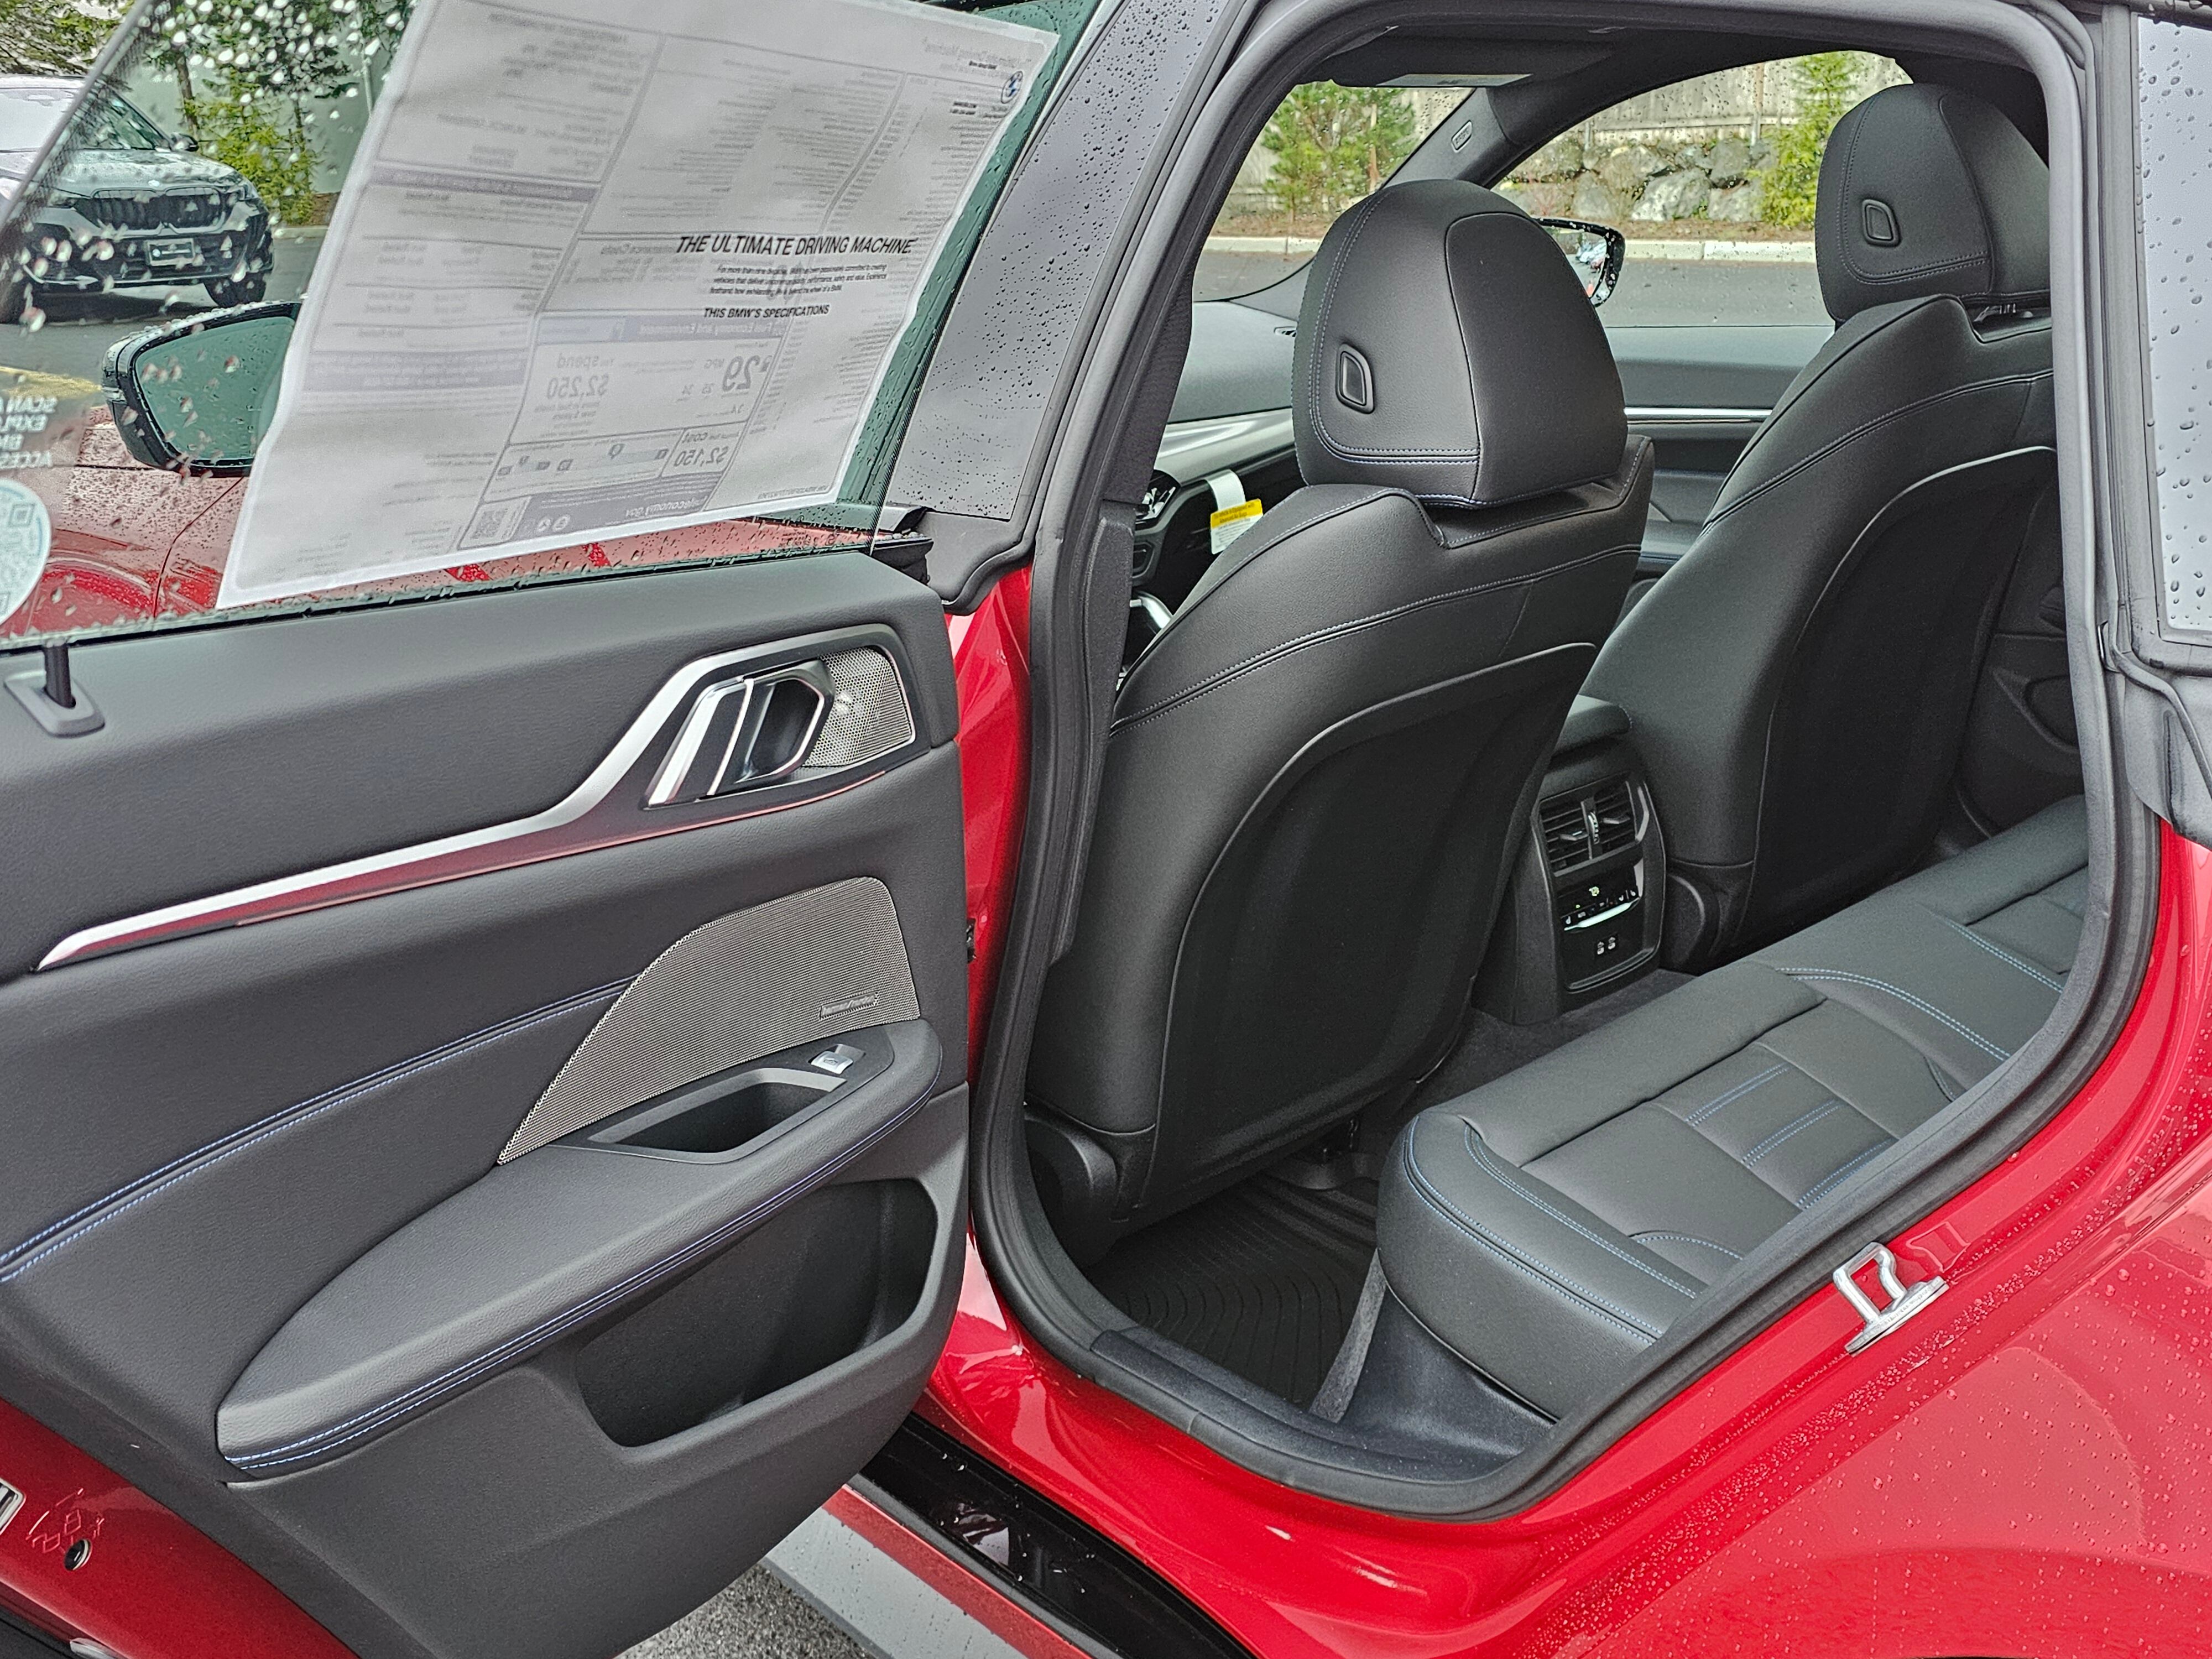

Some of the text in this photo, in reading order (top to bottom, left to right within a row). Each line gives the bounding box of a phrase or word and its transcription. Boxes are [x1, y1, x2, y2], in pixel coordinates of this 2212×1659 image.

[676, 236, 711, 253] THE
[712, 236, 795, 255] ULTIMATE
[795, 237, 848, 255] DRIVING
[703, 304, 830, 318] THIS BMW'S SPECIFICATIONS
